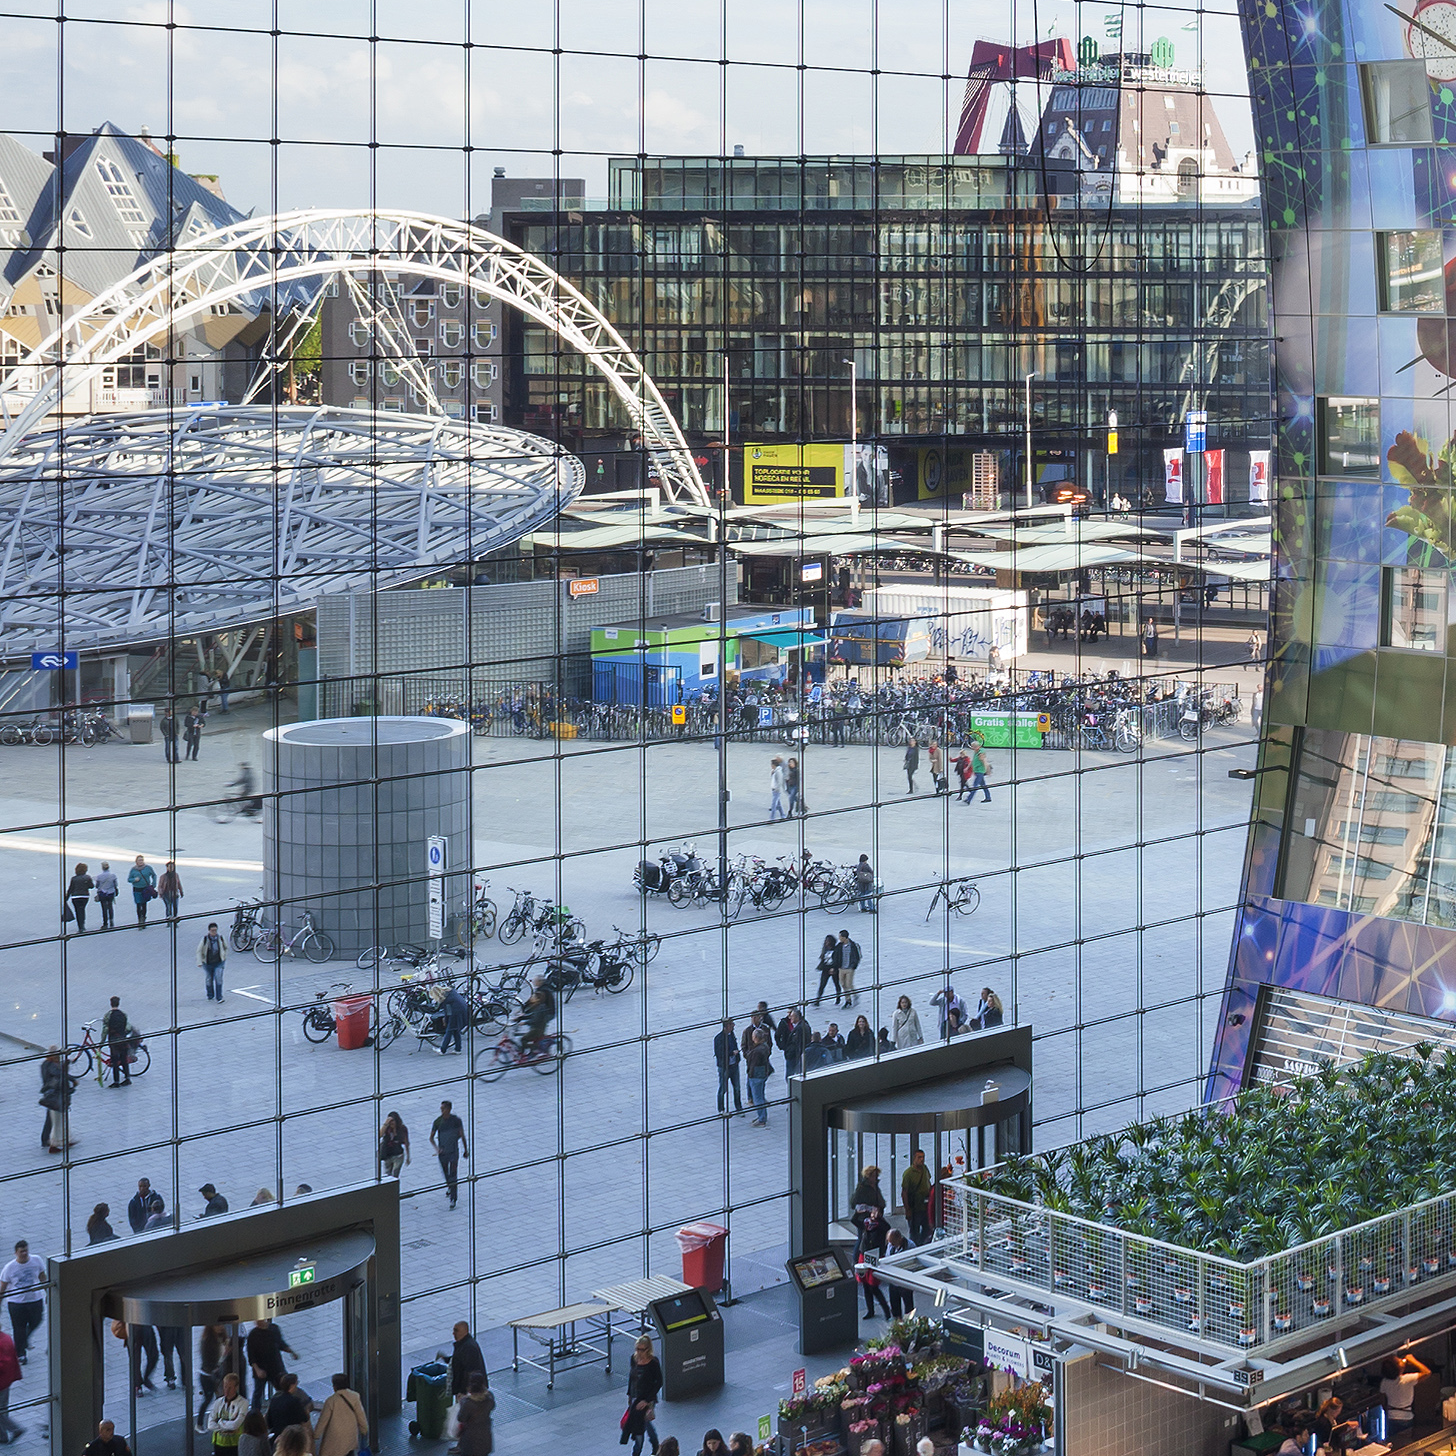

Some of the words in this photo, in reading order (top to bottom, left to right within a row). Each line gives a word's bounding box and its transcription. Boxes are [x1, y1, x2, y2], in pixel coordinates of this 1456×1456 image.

[1131, 66, 1201, 86] westermeije
[573, 581, 596, 593] Kiosk
[974, 717, 1004, 728] Gratis
[1007, 718, 1038, 728] salle
[267, 1284, 336, 1309] Binnenrotte
[988, 1341, 1021, 1360] Decorum
[794, 1375, 805, 1391] 15
[1234, 1370, 1249, 1383] 89
[1250, 1369, 1264, 1384] 89
[760, 1423, 770, 1438] 10
